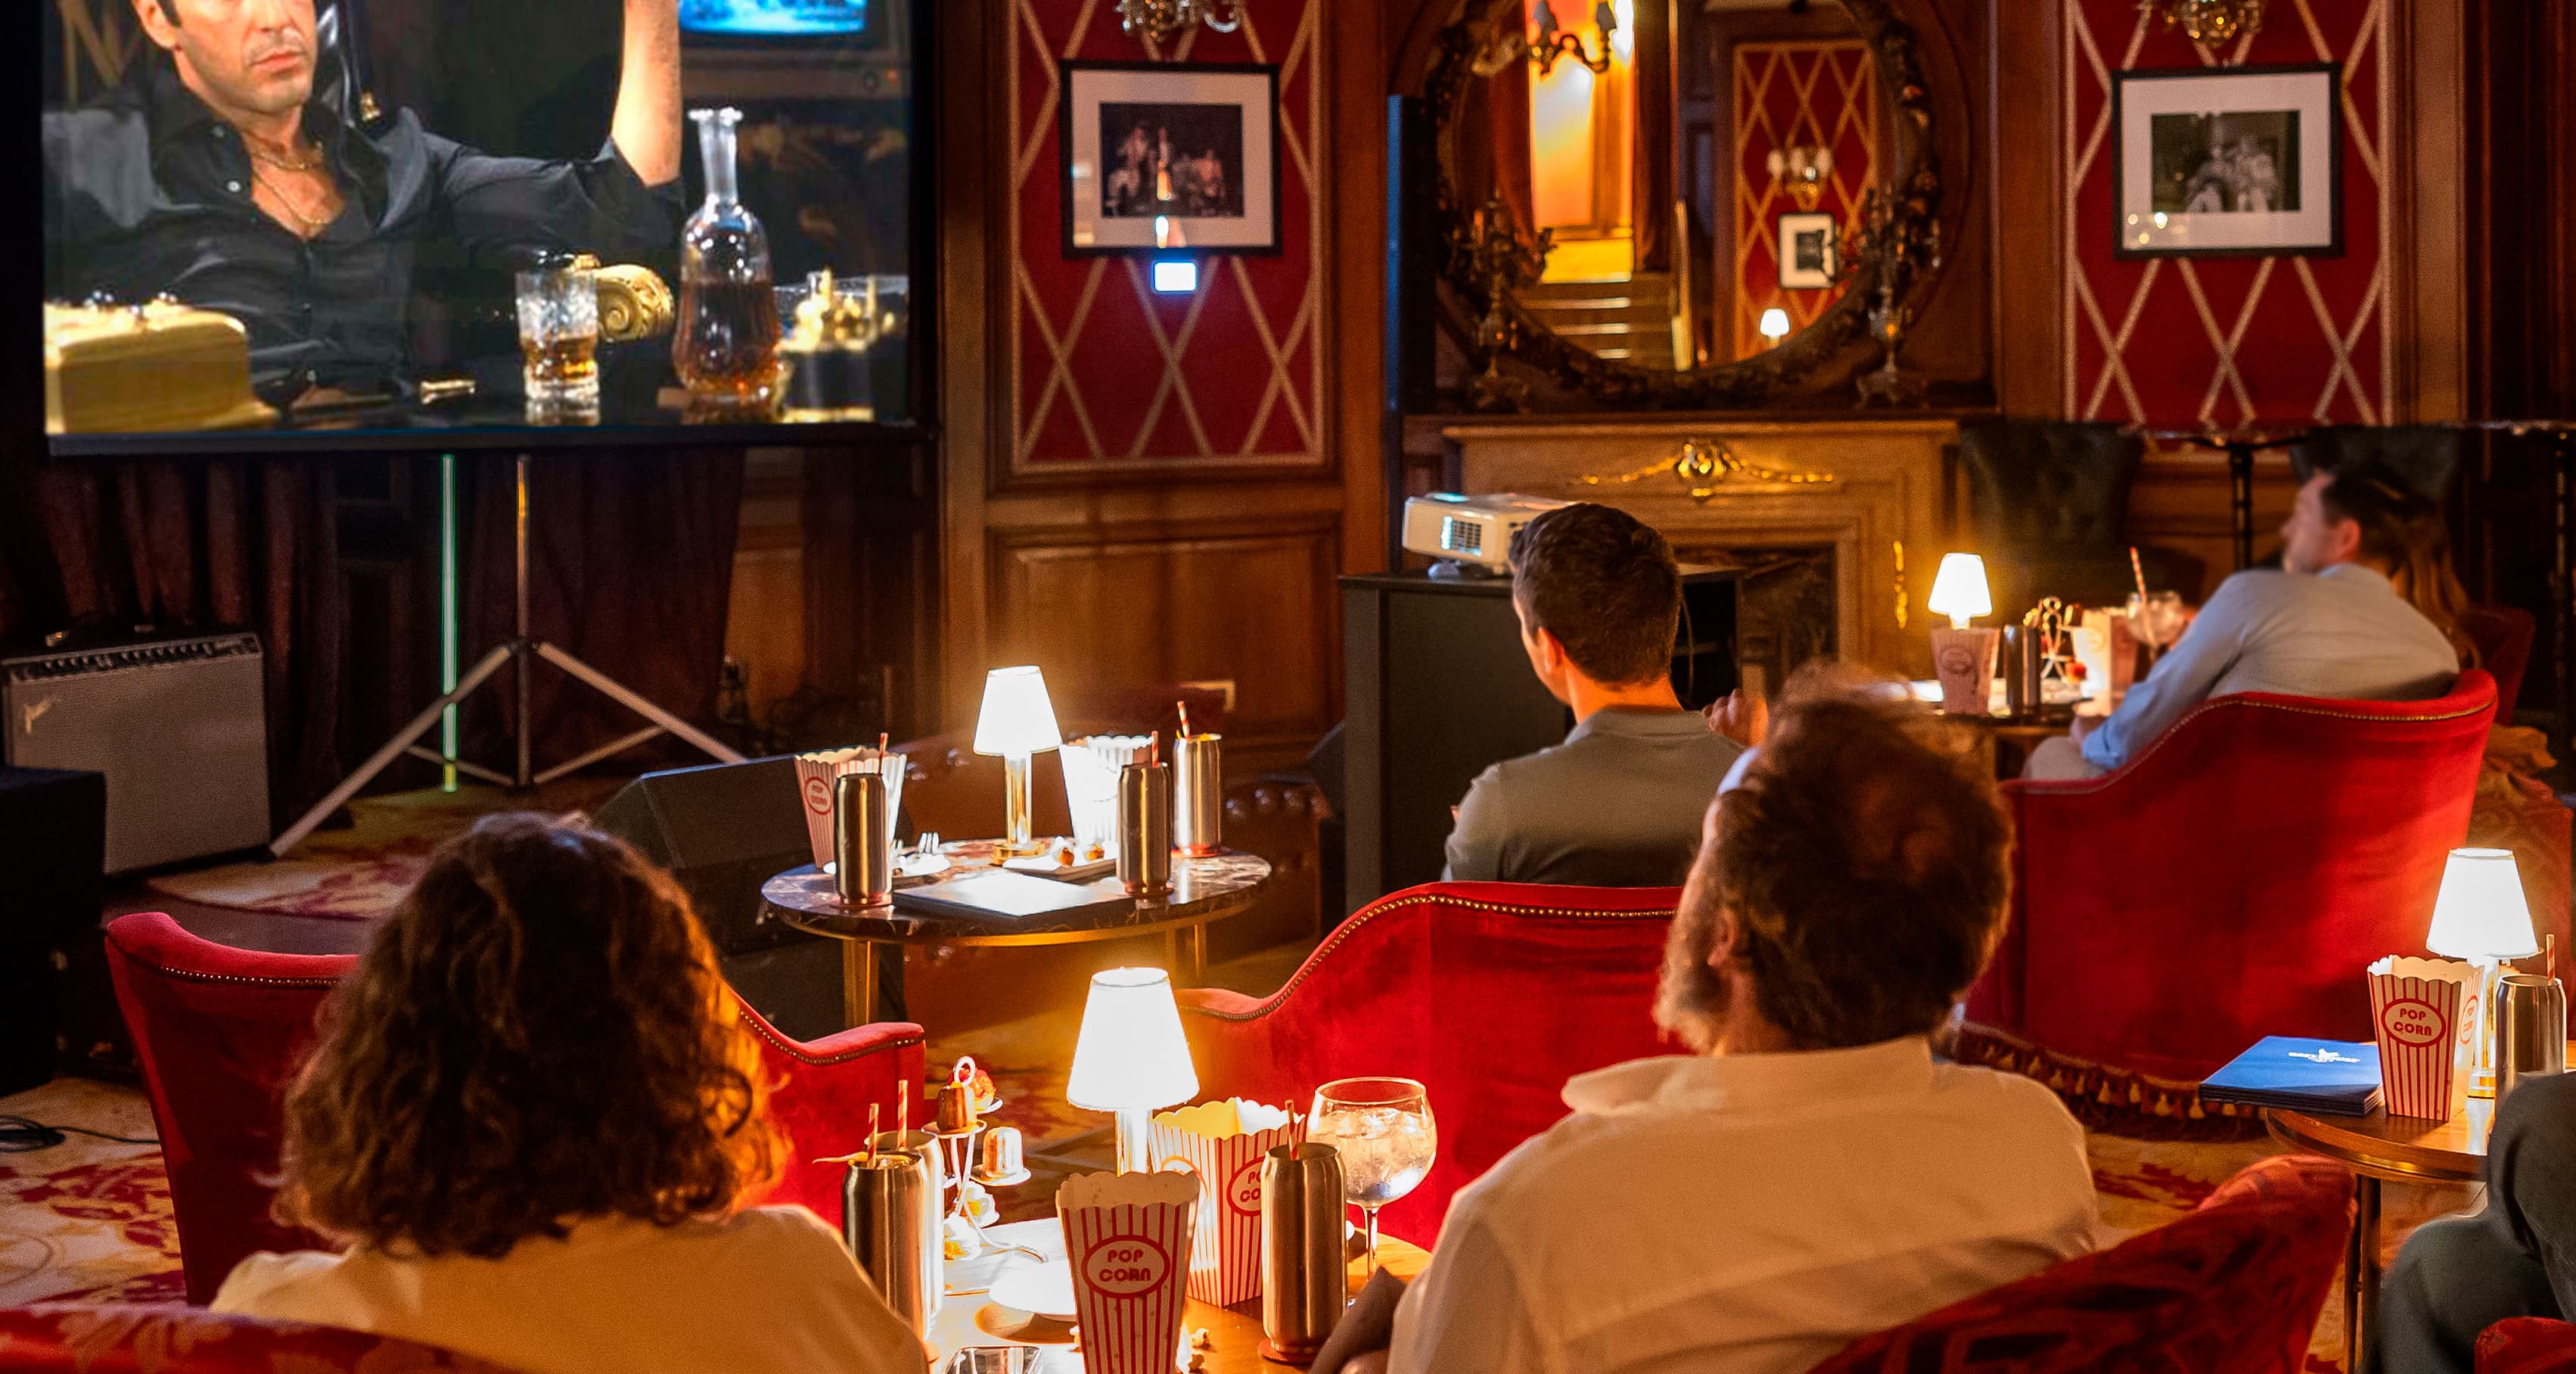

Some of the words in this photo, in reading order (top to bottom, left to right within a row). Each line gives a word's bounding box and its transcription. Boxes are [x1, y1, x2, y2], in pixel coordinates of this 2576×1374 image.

[2400, 1008, 2426, 1021] POP
[2394, 1021, 2432, 1037] CORN
[1239, 1188, 1261, 1202] CO
[1107, 1249, 1144, 1263] POP
[1098, 1268, 1151, 1282] CORN
